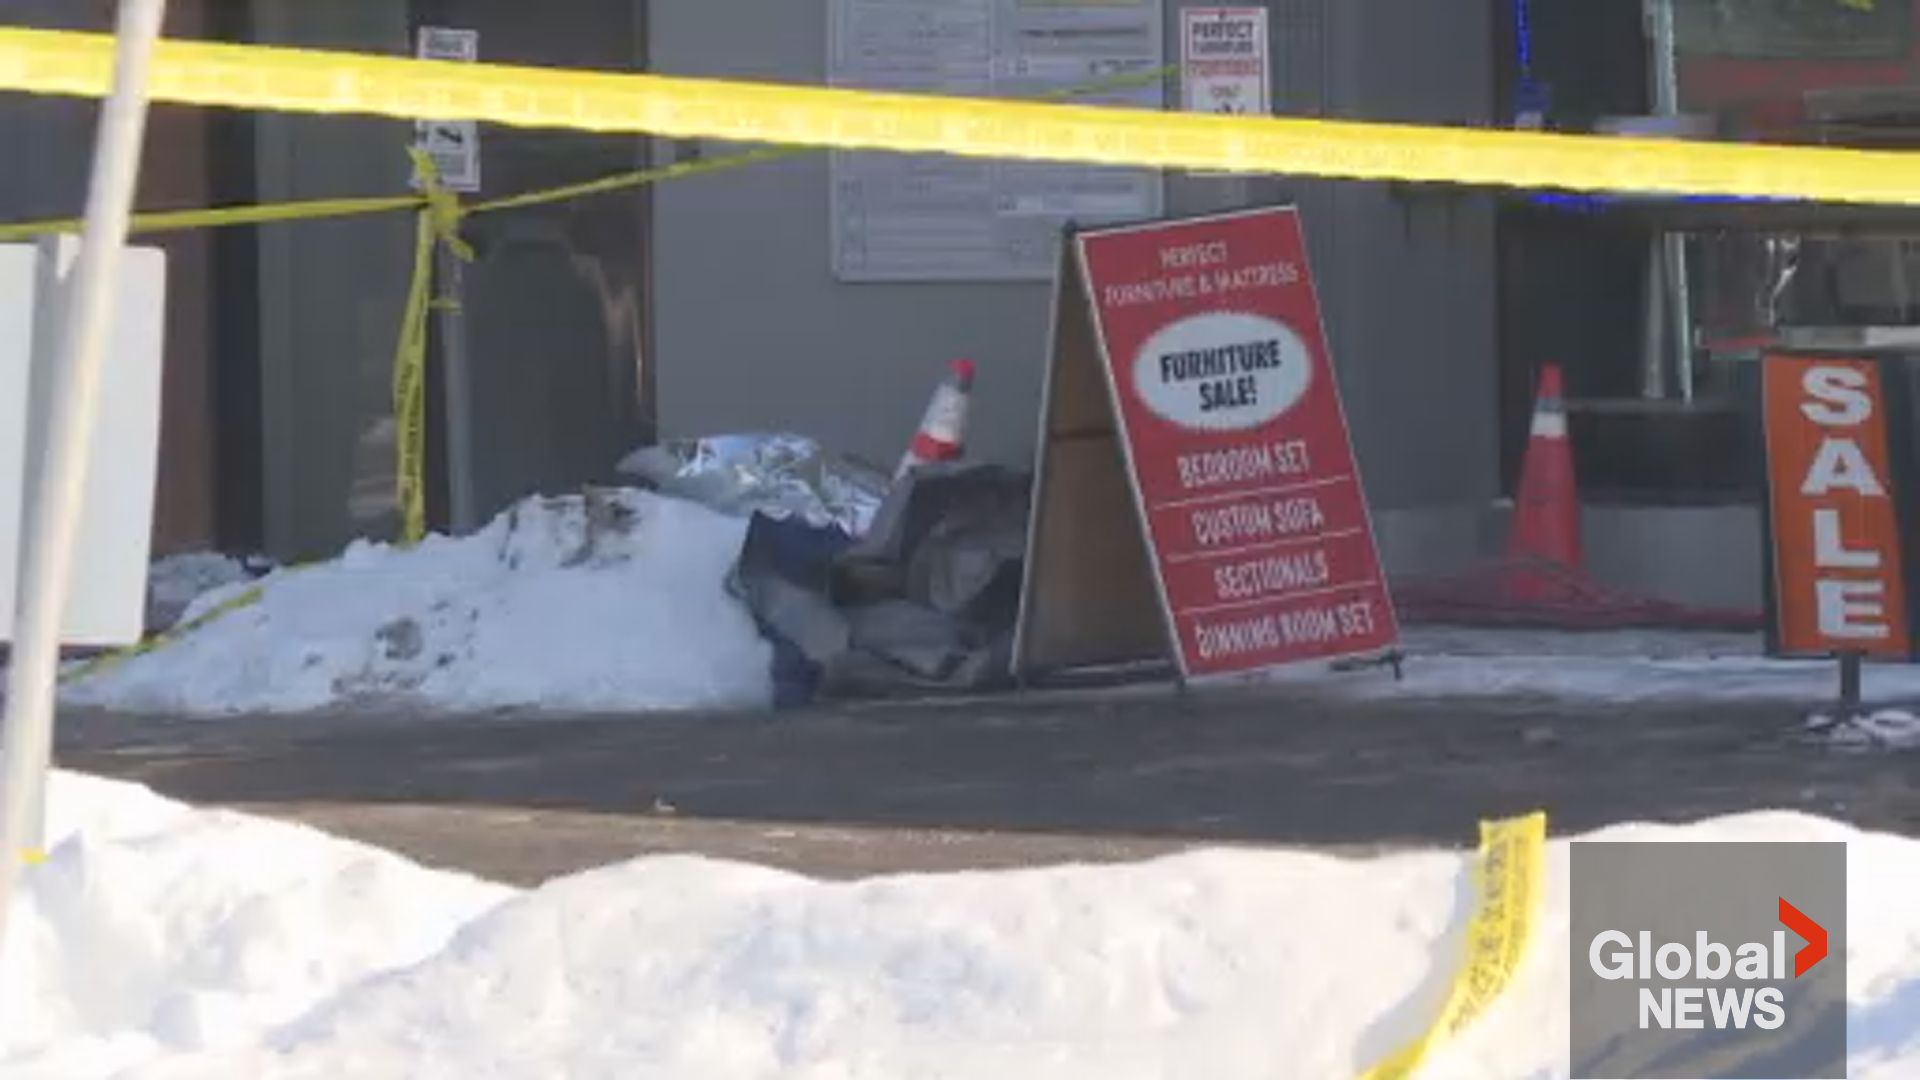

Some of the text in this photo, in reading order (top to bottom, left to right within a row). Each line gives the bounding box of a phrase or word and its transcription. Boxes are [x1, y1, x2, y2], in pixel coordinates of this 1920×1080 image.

[1192, 20, 1253, 38] PERFECT
[1159, 241, 1228, 268] PERFECT
[1105, 261, 1299, 306] FURNITURE & MATTRESS
[1160, 340, 1281, 383] FURNITURE
[1200, 374, 1257, 412] SALE!
[1177, 440, 1310, 488] BEDROOM SET
[1192, 499, 1324, 545] CUSTOM SOFA
[1799, 366, 1891, 638] SALE
[1214, 550, 1329, 598] SECTIONALS
[1279, 607, 1337, 646] ROOM
[1337, 602, 1375, 637] SET
